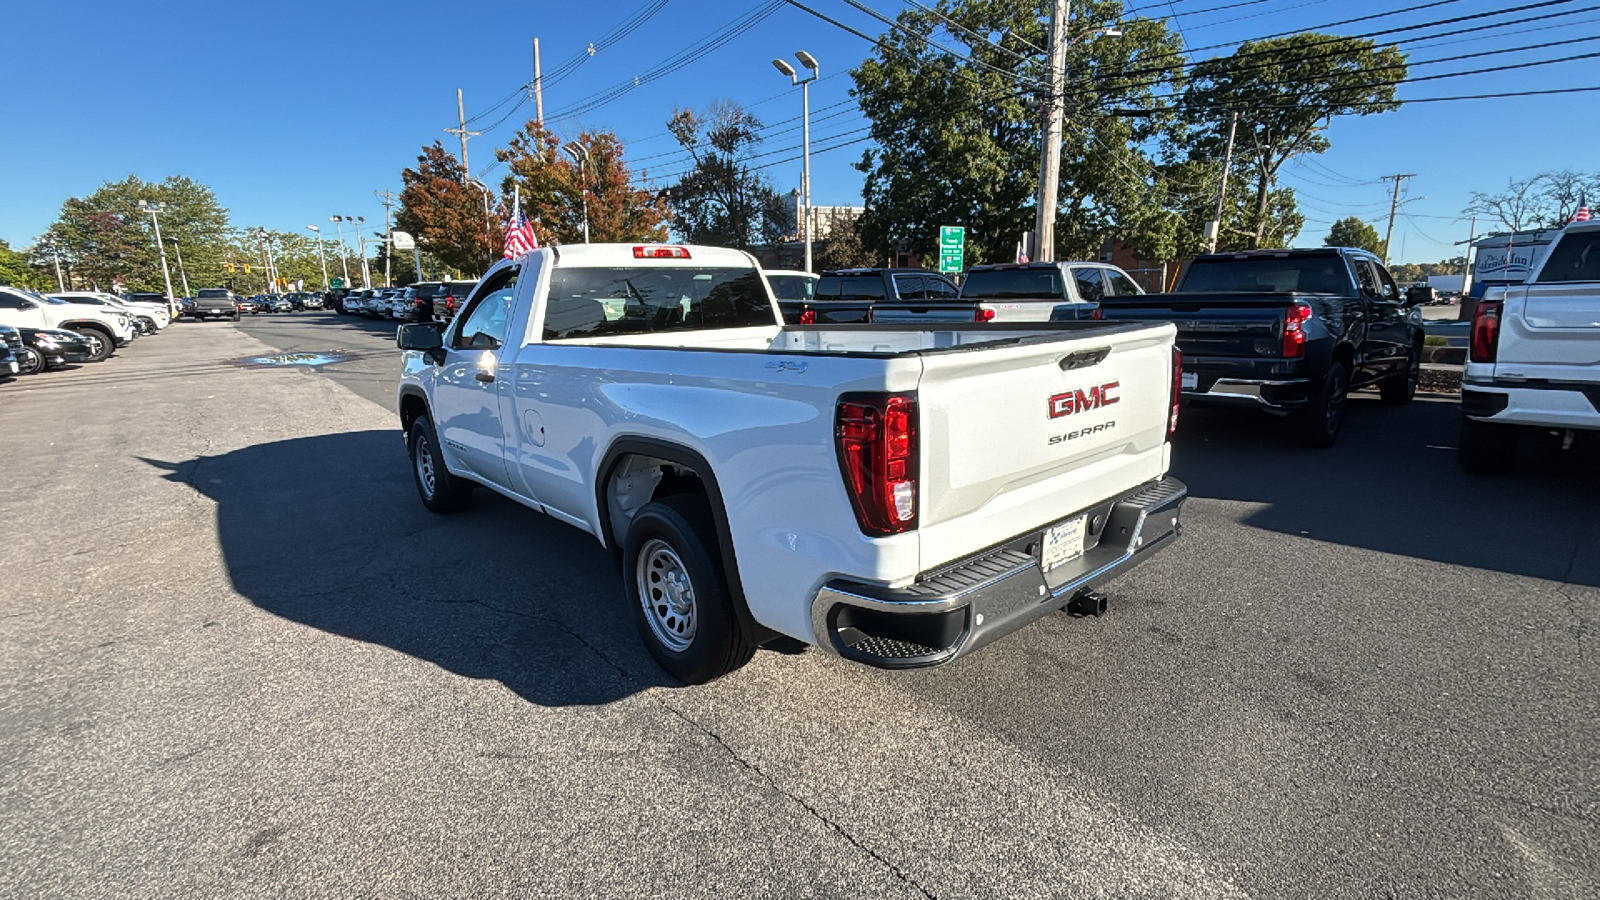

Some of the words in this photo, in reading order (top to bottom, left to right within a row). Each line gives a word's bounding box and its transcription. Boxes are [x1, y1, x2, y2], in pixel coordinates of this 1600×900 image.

[1511, 253, 1527, 265] Inn
[1047, 379, 1120, 420] GMC
[1047, 420, 1116, 446] SIERRA
